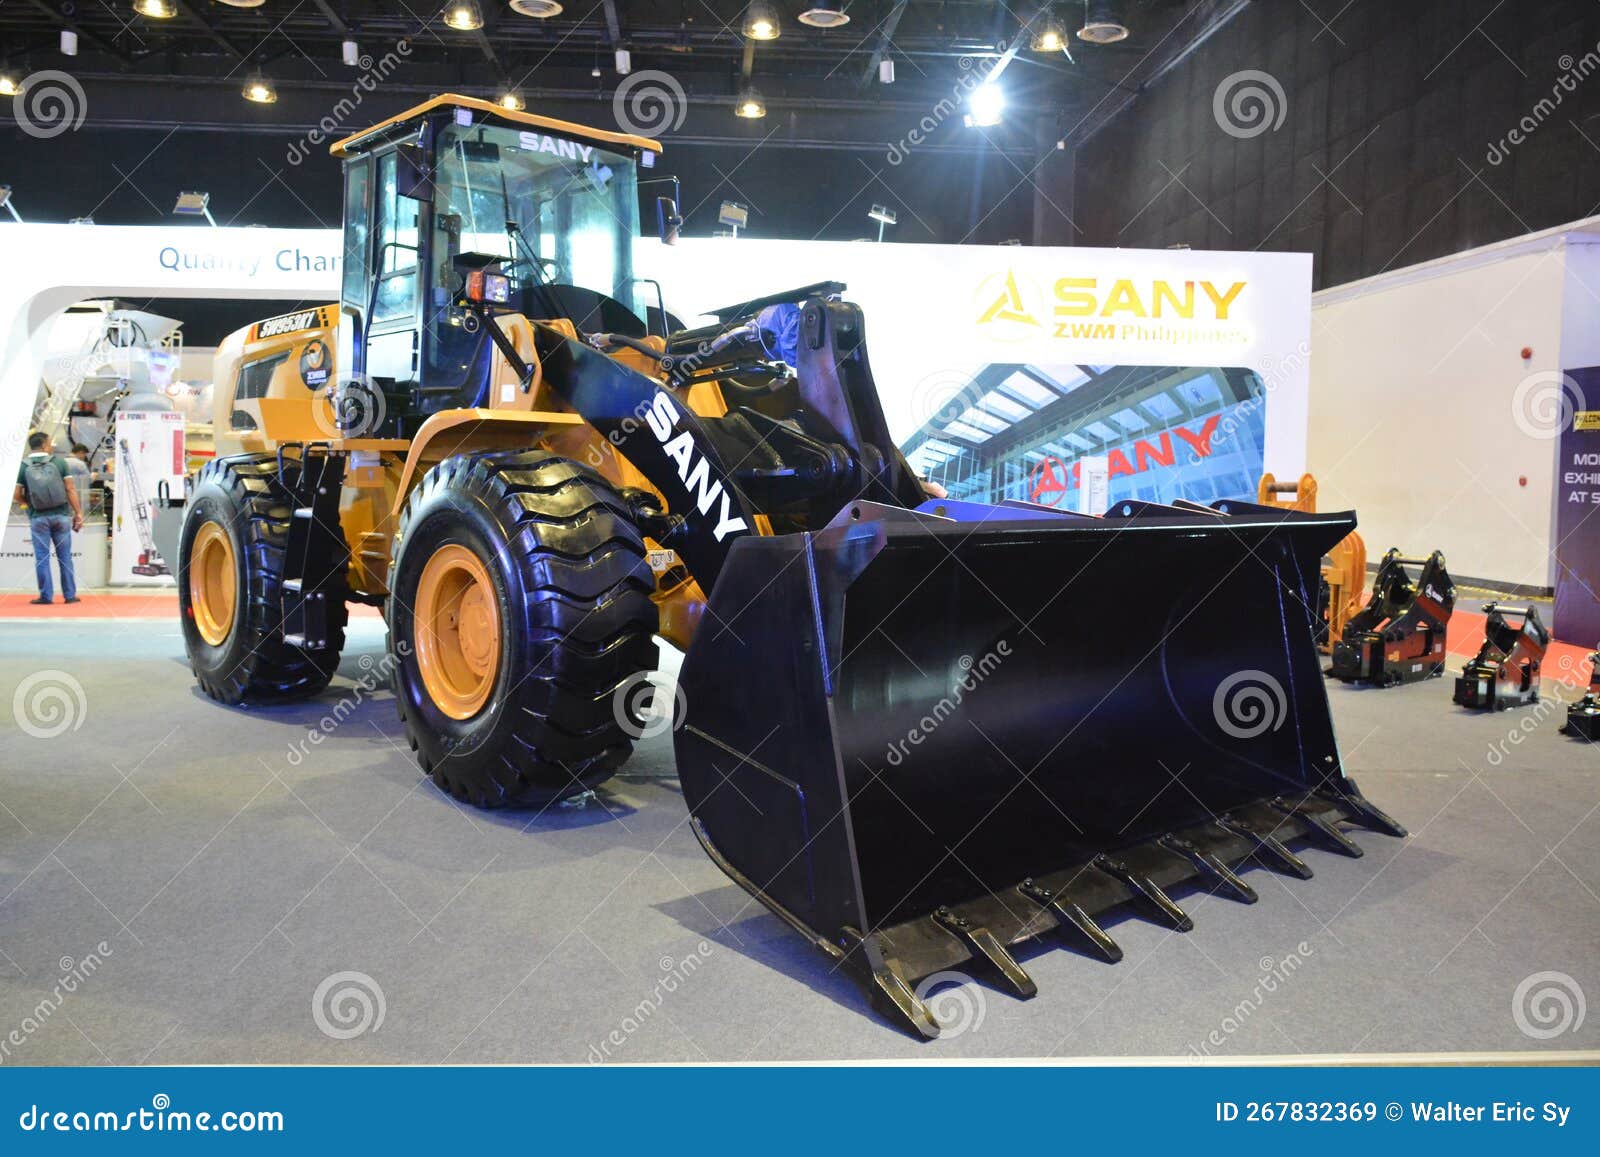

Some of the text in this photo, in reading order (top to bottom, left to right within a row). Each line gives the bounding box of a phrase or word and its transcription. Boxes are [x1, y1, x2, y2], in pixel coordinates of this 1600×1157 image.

[519, 131, 593, 163] SANY
[1053, 277, 1248, 320] SANY
[1053, 322, 1116, 340] ZWM
[644, 391, 748, 543] SANY
[1574, 453, 1600, 465] MO
[1568, 490, 1588, 503] AT
